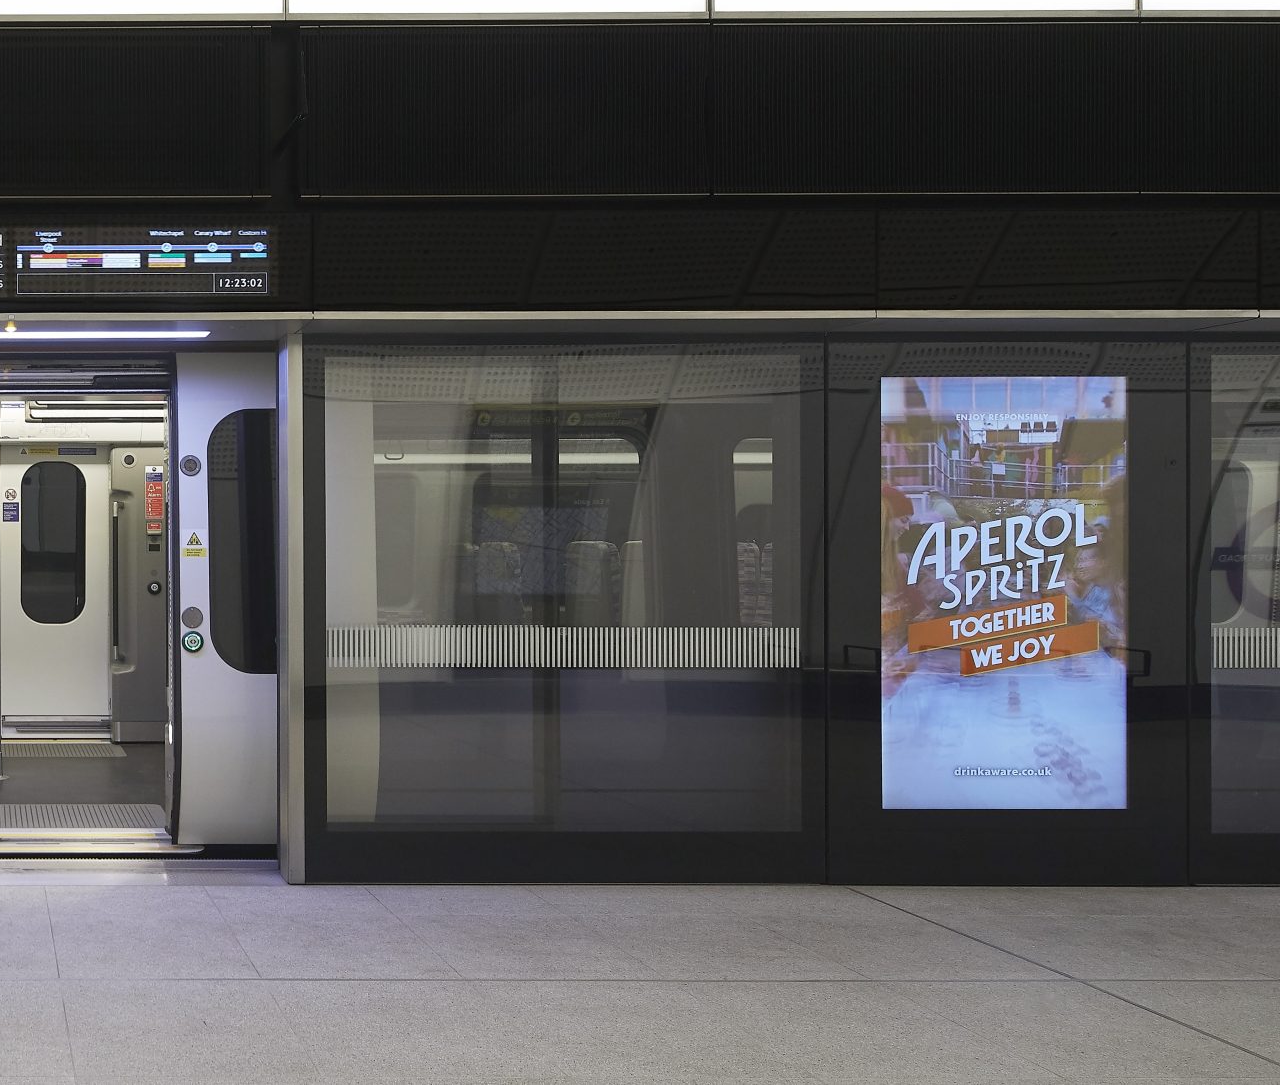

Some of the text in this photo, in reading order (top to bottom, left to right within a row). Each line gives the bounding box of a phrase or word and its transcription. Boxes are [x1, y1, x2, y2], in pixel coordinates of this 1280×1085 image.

[219, 277, 263, 288] 12:23:02
[956, 413, 1049, 421] ENJOY RESPONSIBLY
[907, 504, 1098, 585] APEROL
[949, 602, 1056, 640] TOGETHER
[970, 634, 1056, 669] WE JOY
[954, 766, 1052, 776] drinkaware.co.uk
